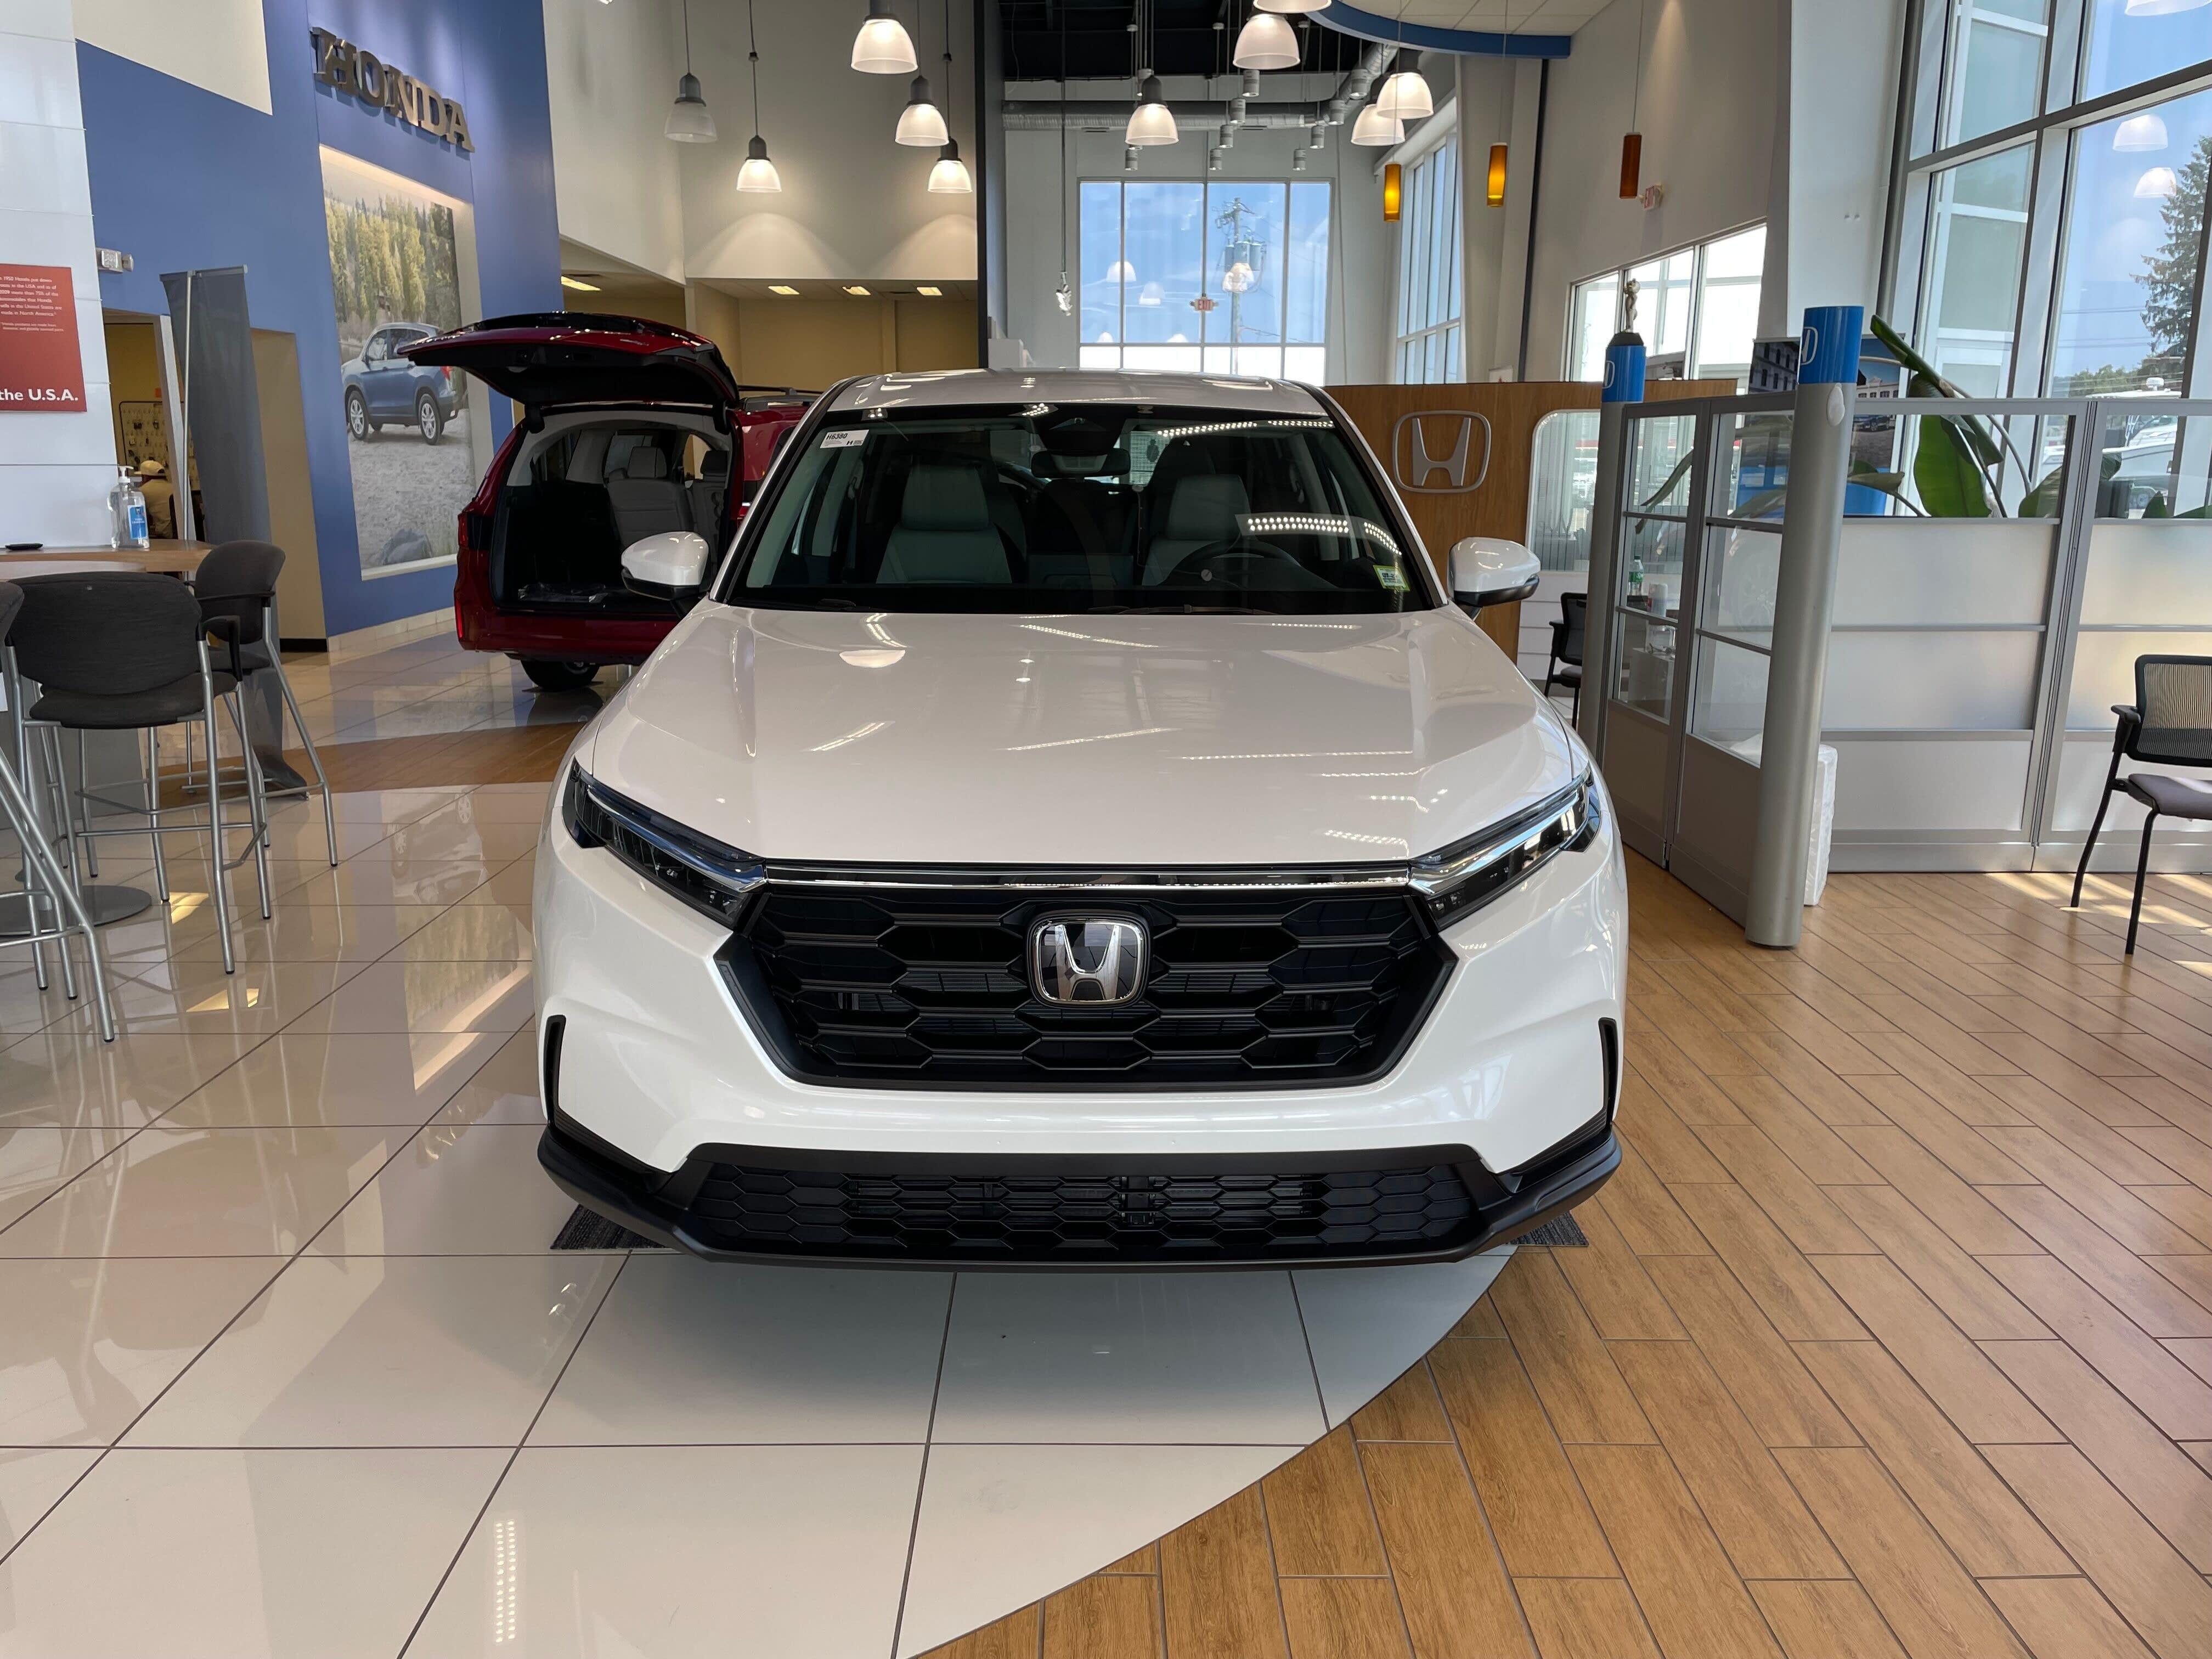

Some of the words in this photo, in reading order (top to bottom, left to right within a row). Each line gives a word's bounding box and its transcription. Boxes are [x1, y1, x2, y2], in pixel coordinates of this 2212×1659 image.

[310, 27, 475, 153] HONDA
[0, 388, 24, 400] the
[28, 388, 78, 401] U.S.A.
